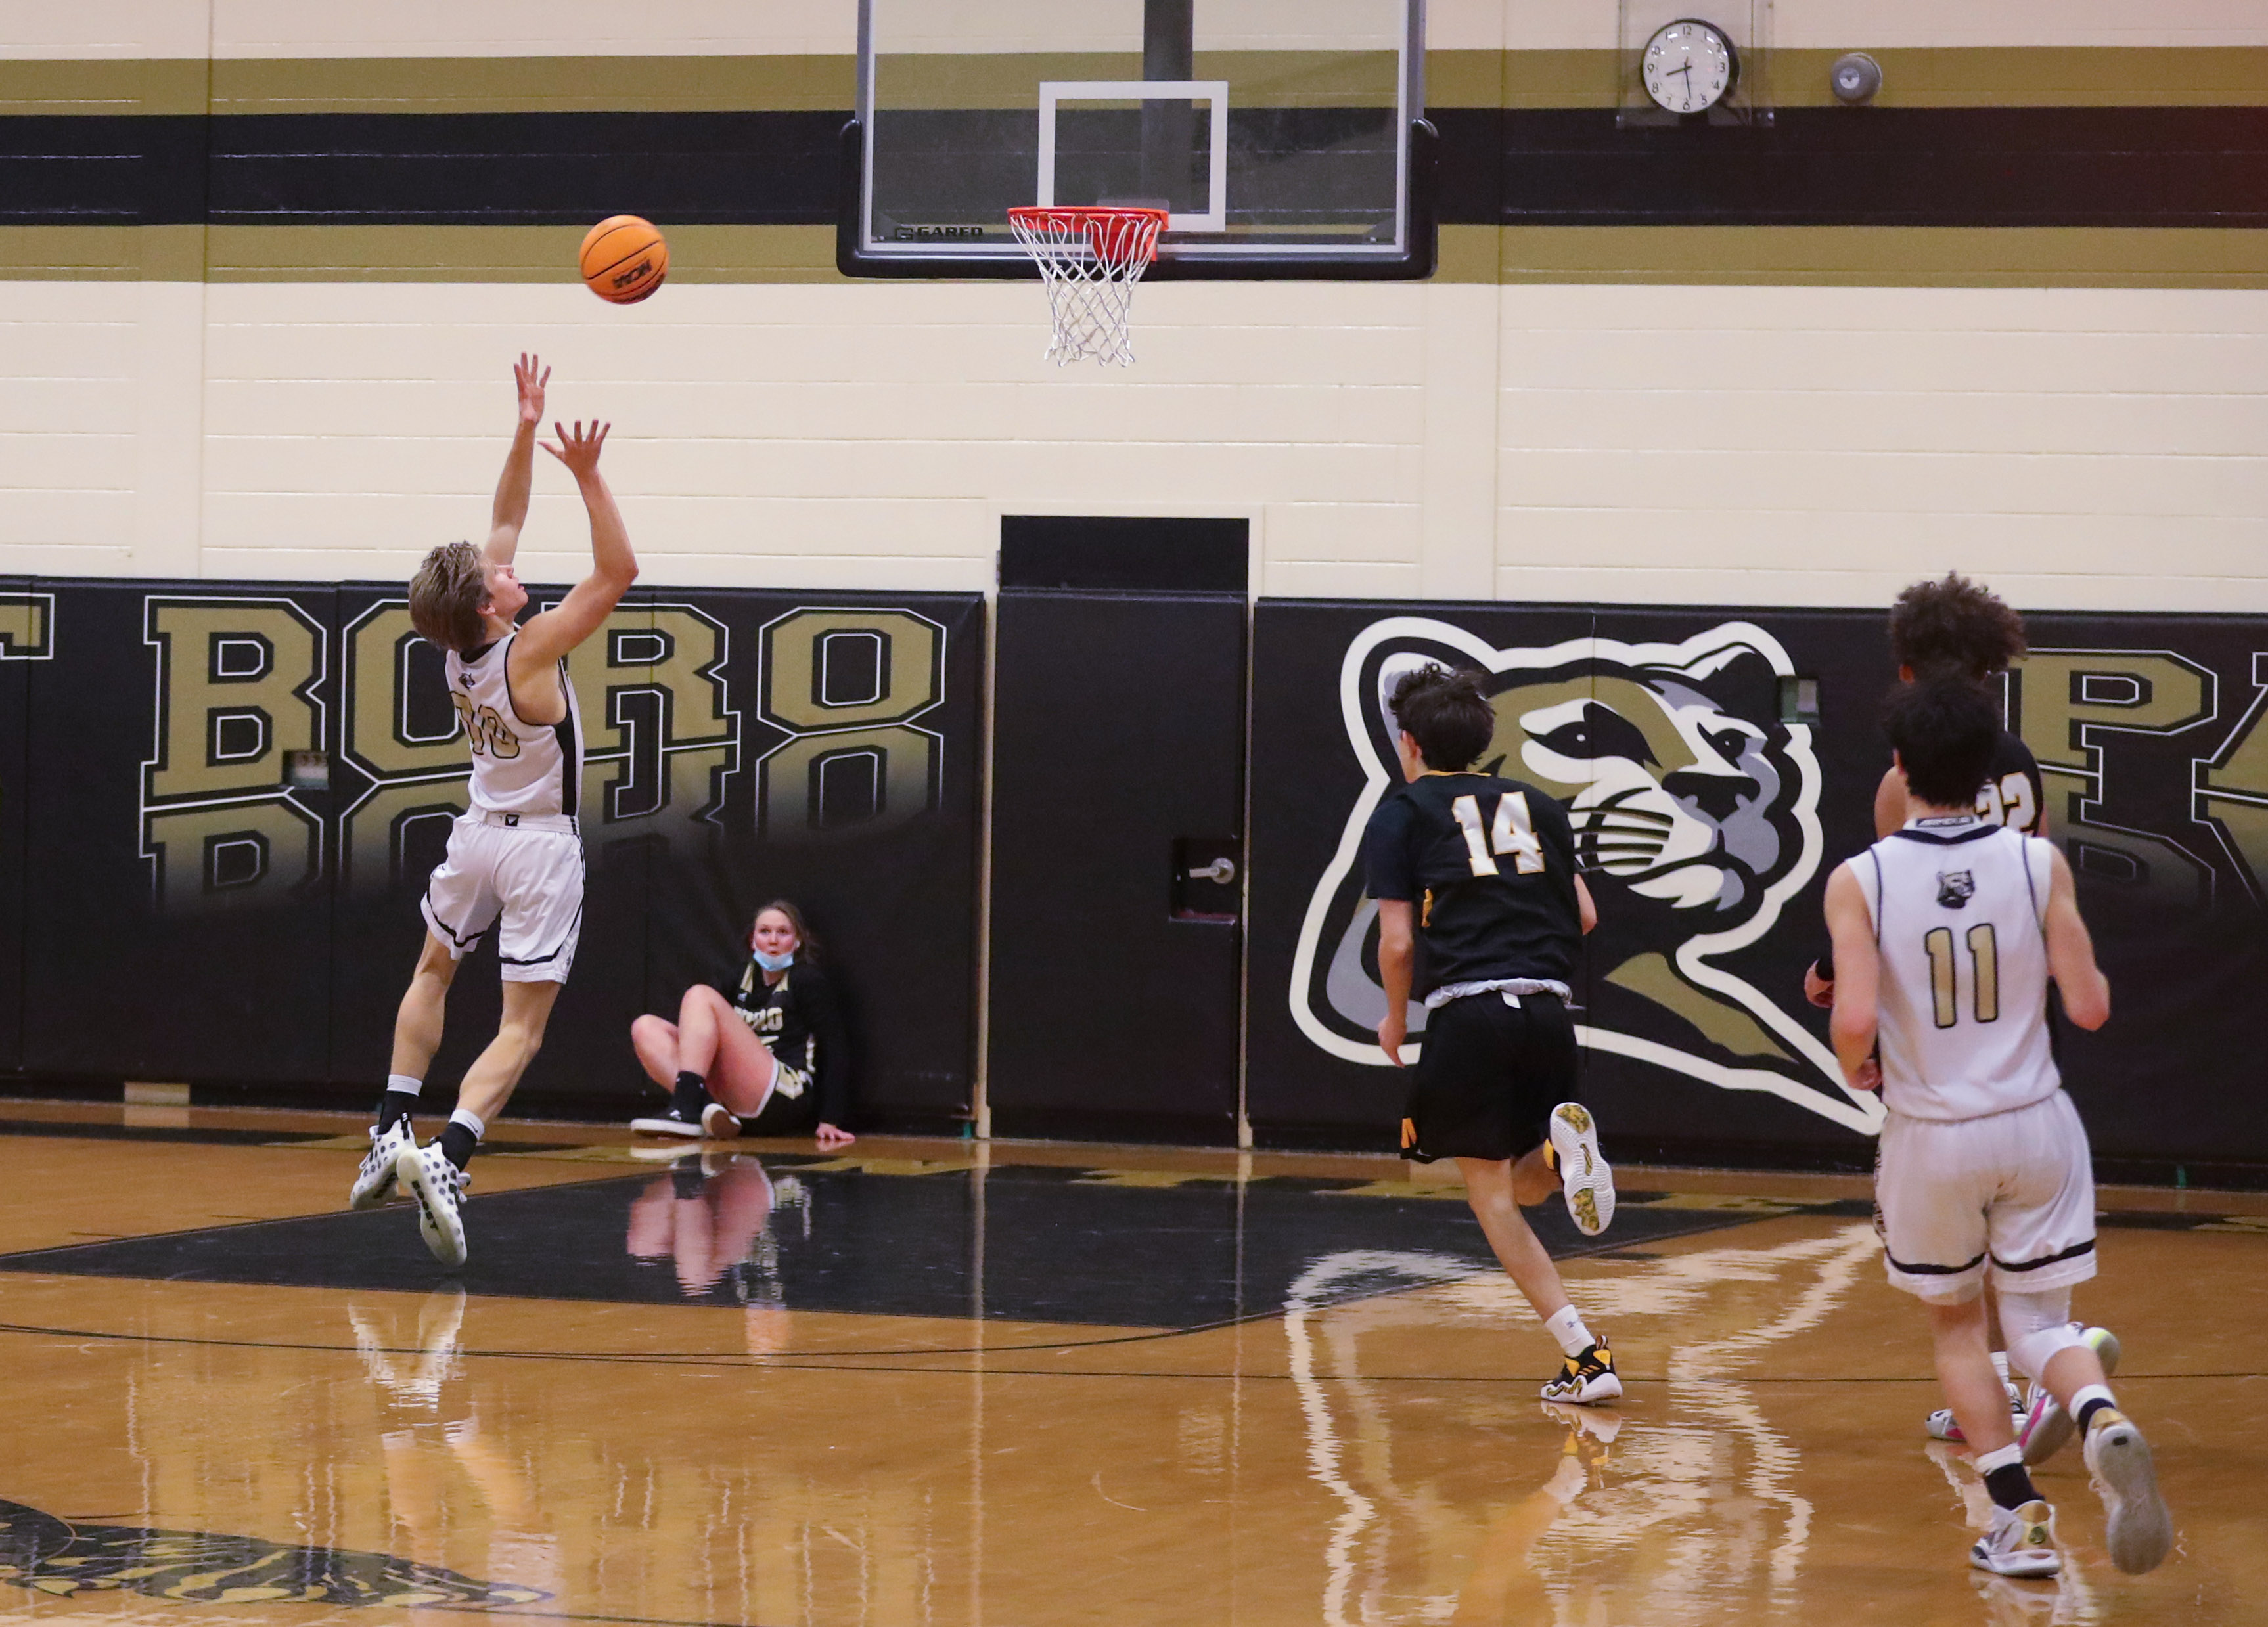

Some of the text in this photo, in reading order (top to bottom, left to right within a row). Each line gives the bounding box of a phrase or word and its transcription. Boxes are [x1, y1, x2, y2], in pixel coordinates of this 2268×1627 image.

[1683, 25, 1692, 35] 12
[1716, 43, 1722, 53] 2
[1647, 63, 1654, 74] 9
[1719, 62, 1725, 73] 3
[1652, 82, 1659, 94] 8
[1713, 79, 1720, 91] 4
[1683, 99, 1690, 111] 6
[1701, 95, 1708, 106] 5
[917, 227, 983, 237] GARED
[1451, 791, 1546, 877] 14
[1924, 922, 1999, 1029] 11
